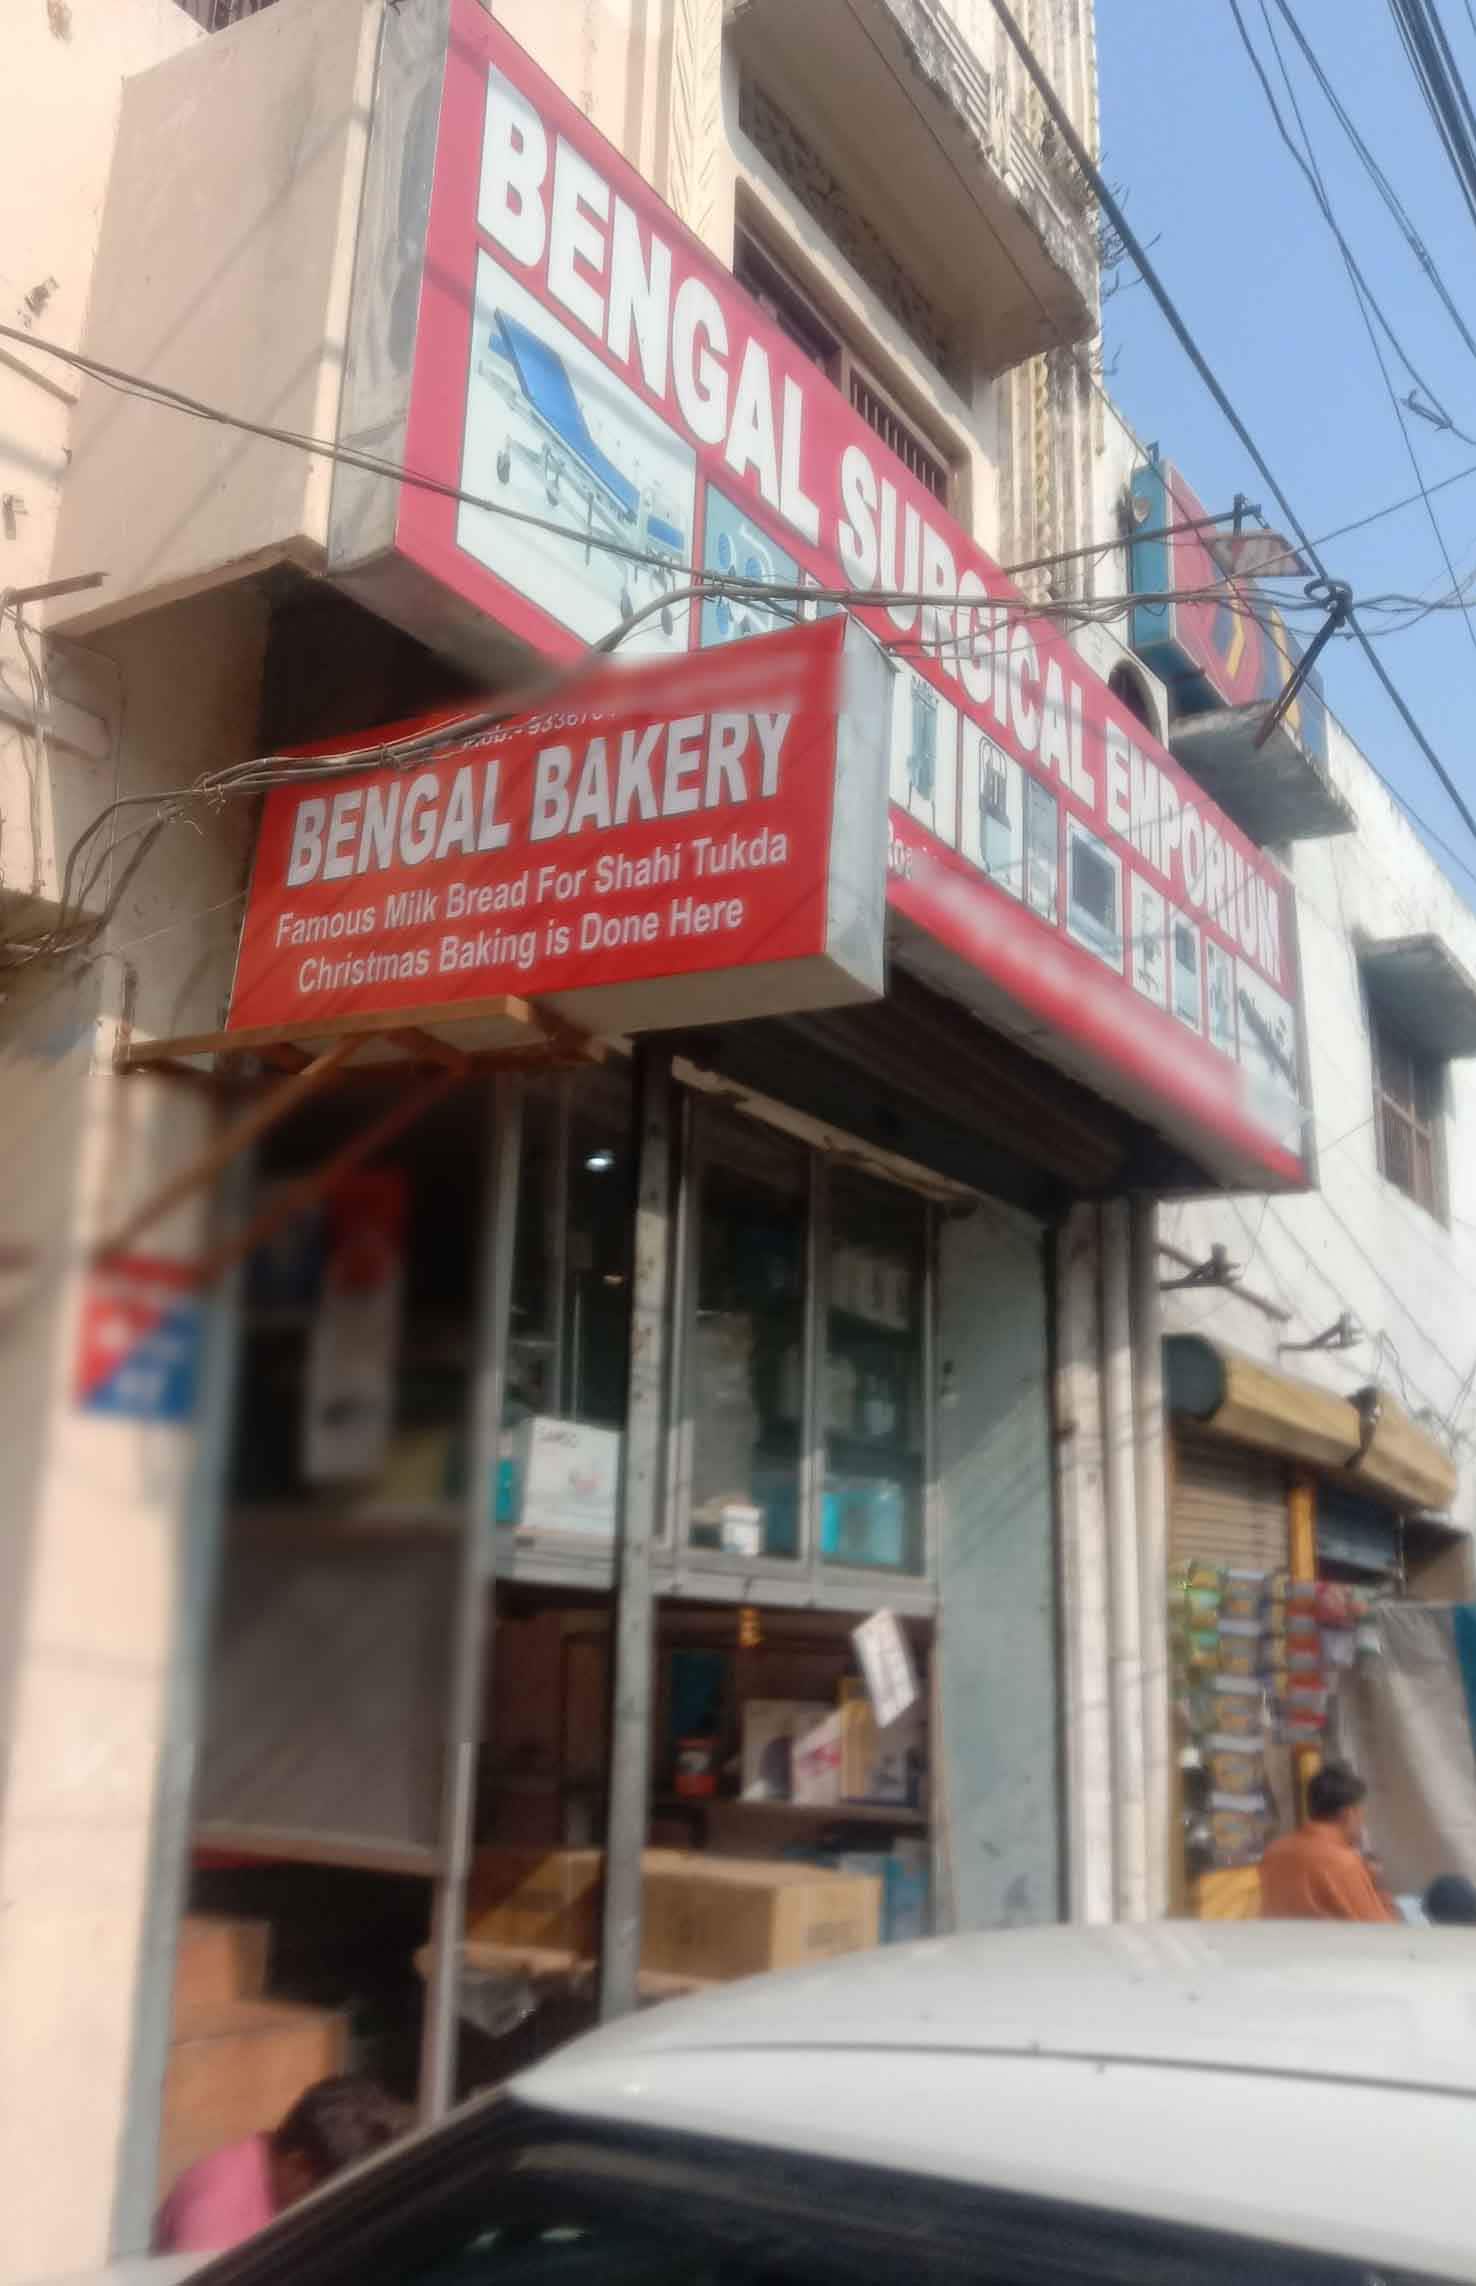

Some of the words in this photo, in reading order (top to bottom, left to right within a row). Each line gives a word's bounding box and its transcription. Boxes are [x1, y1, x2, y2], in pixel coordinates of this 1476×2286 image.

[476, 62, 821, 546] BENGAL
[838, 445, 1095, 811] SURGICAL
[1106, 716, 1282, 985] EMPORIUM
[286, 757, 512, 887] BENGAL
[529, 711, 792, 841] BAKERY
[275, 906, 376, 948] Famous
[384, 887, 439, 929] Milk
[446, 870, 528, 919] Bread
[536, 865, 588, 904] For
[594, 842, 681, 894] Shahi
[691, 827, 788, 877] Tukda
[299, 949, 432, 993] Christmas
[439, 926, 537, 970] Baking
[545, 919, 570, 956] is
[580, 910, 660, 951] Done
[669, 895, 744, 937] Here
